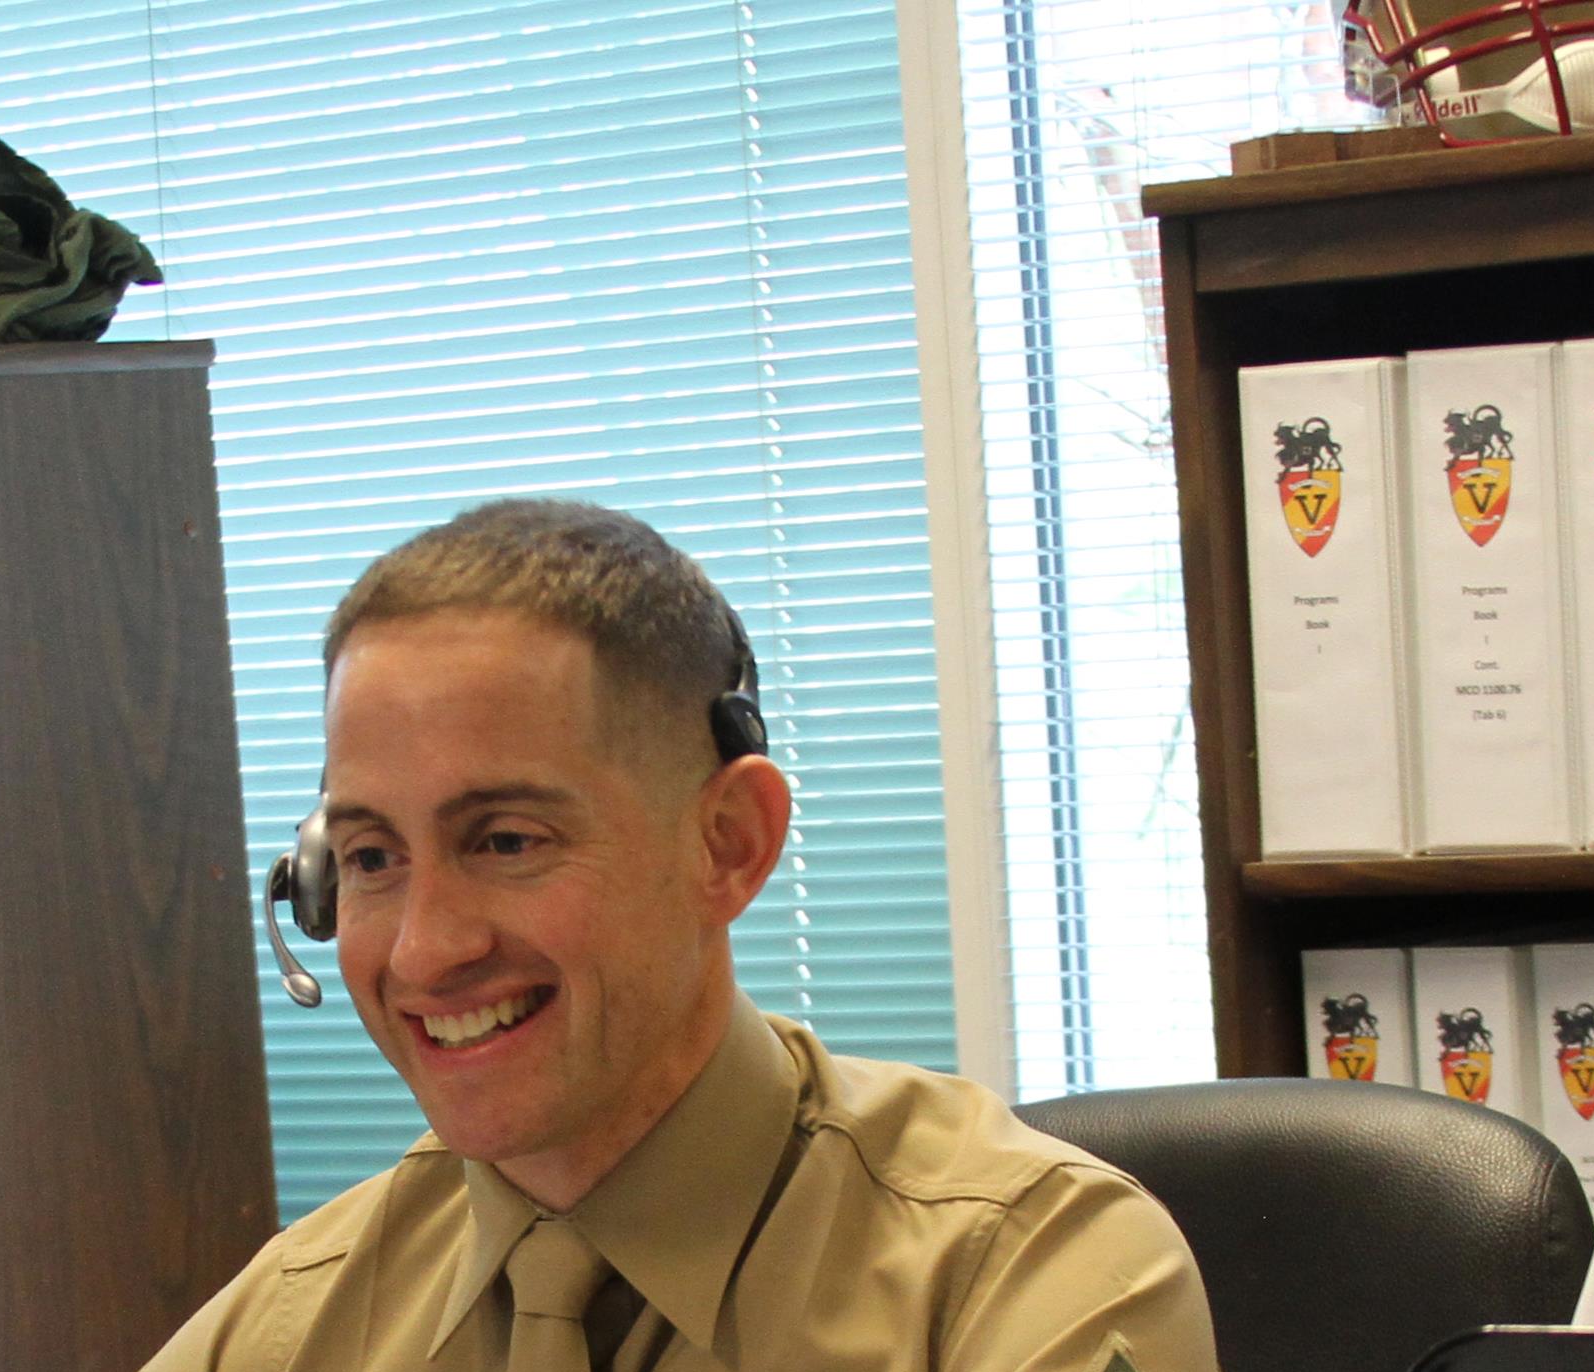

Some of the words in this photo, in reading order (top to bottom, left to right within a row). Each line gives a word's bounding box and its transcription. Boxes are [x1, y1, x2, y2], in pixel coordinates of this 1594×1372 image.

[1464, 483, 1496, 513] V
[1295, 494, 1327, 524] V
[1462, 586, 1507, 597] Programs
[1294, 596, 1339, 607] Programs
[1474, 610, 1498, 620] Book
[1305, 620, 1330, 629] Book
[1339, 1057, 1366, 1080] V
[1454, 1072, 1480, 1096] V
